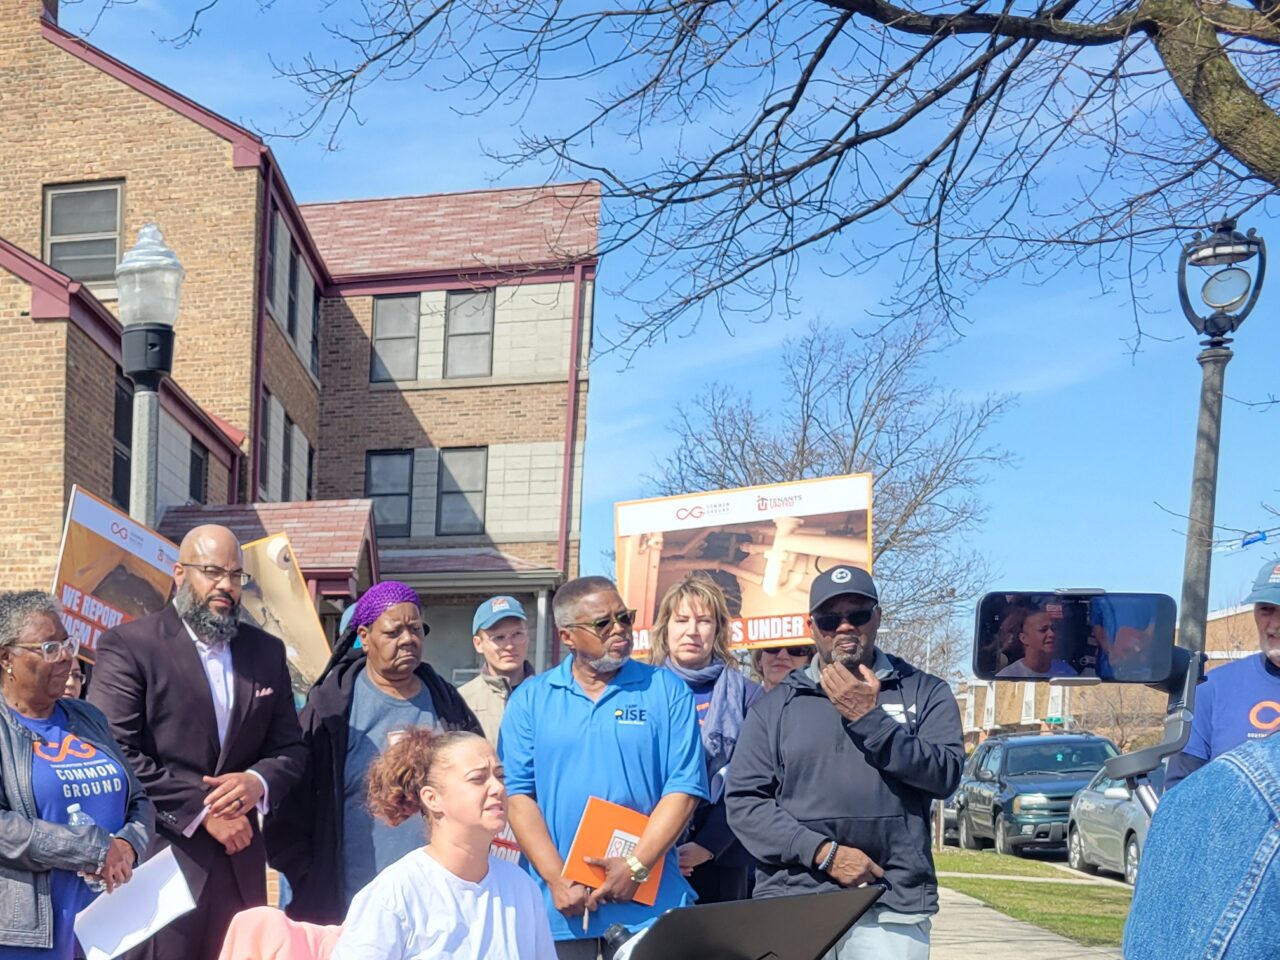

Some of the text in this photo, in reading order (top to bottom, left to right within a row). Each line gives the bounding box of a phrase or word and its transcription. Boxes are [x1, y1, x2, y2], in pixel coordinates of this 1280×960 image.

[62, 584, 82, 611] WE
[747, 616, 804, 641] UNDER
[615, 708, 648, 721] RISE
[55, 763, 118, 781] COMMON
[62, 777, 122, 798] GROUND
